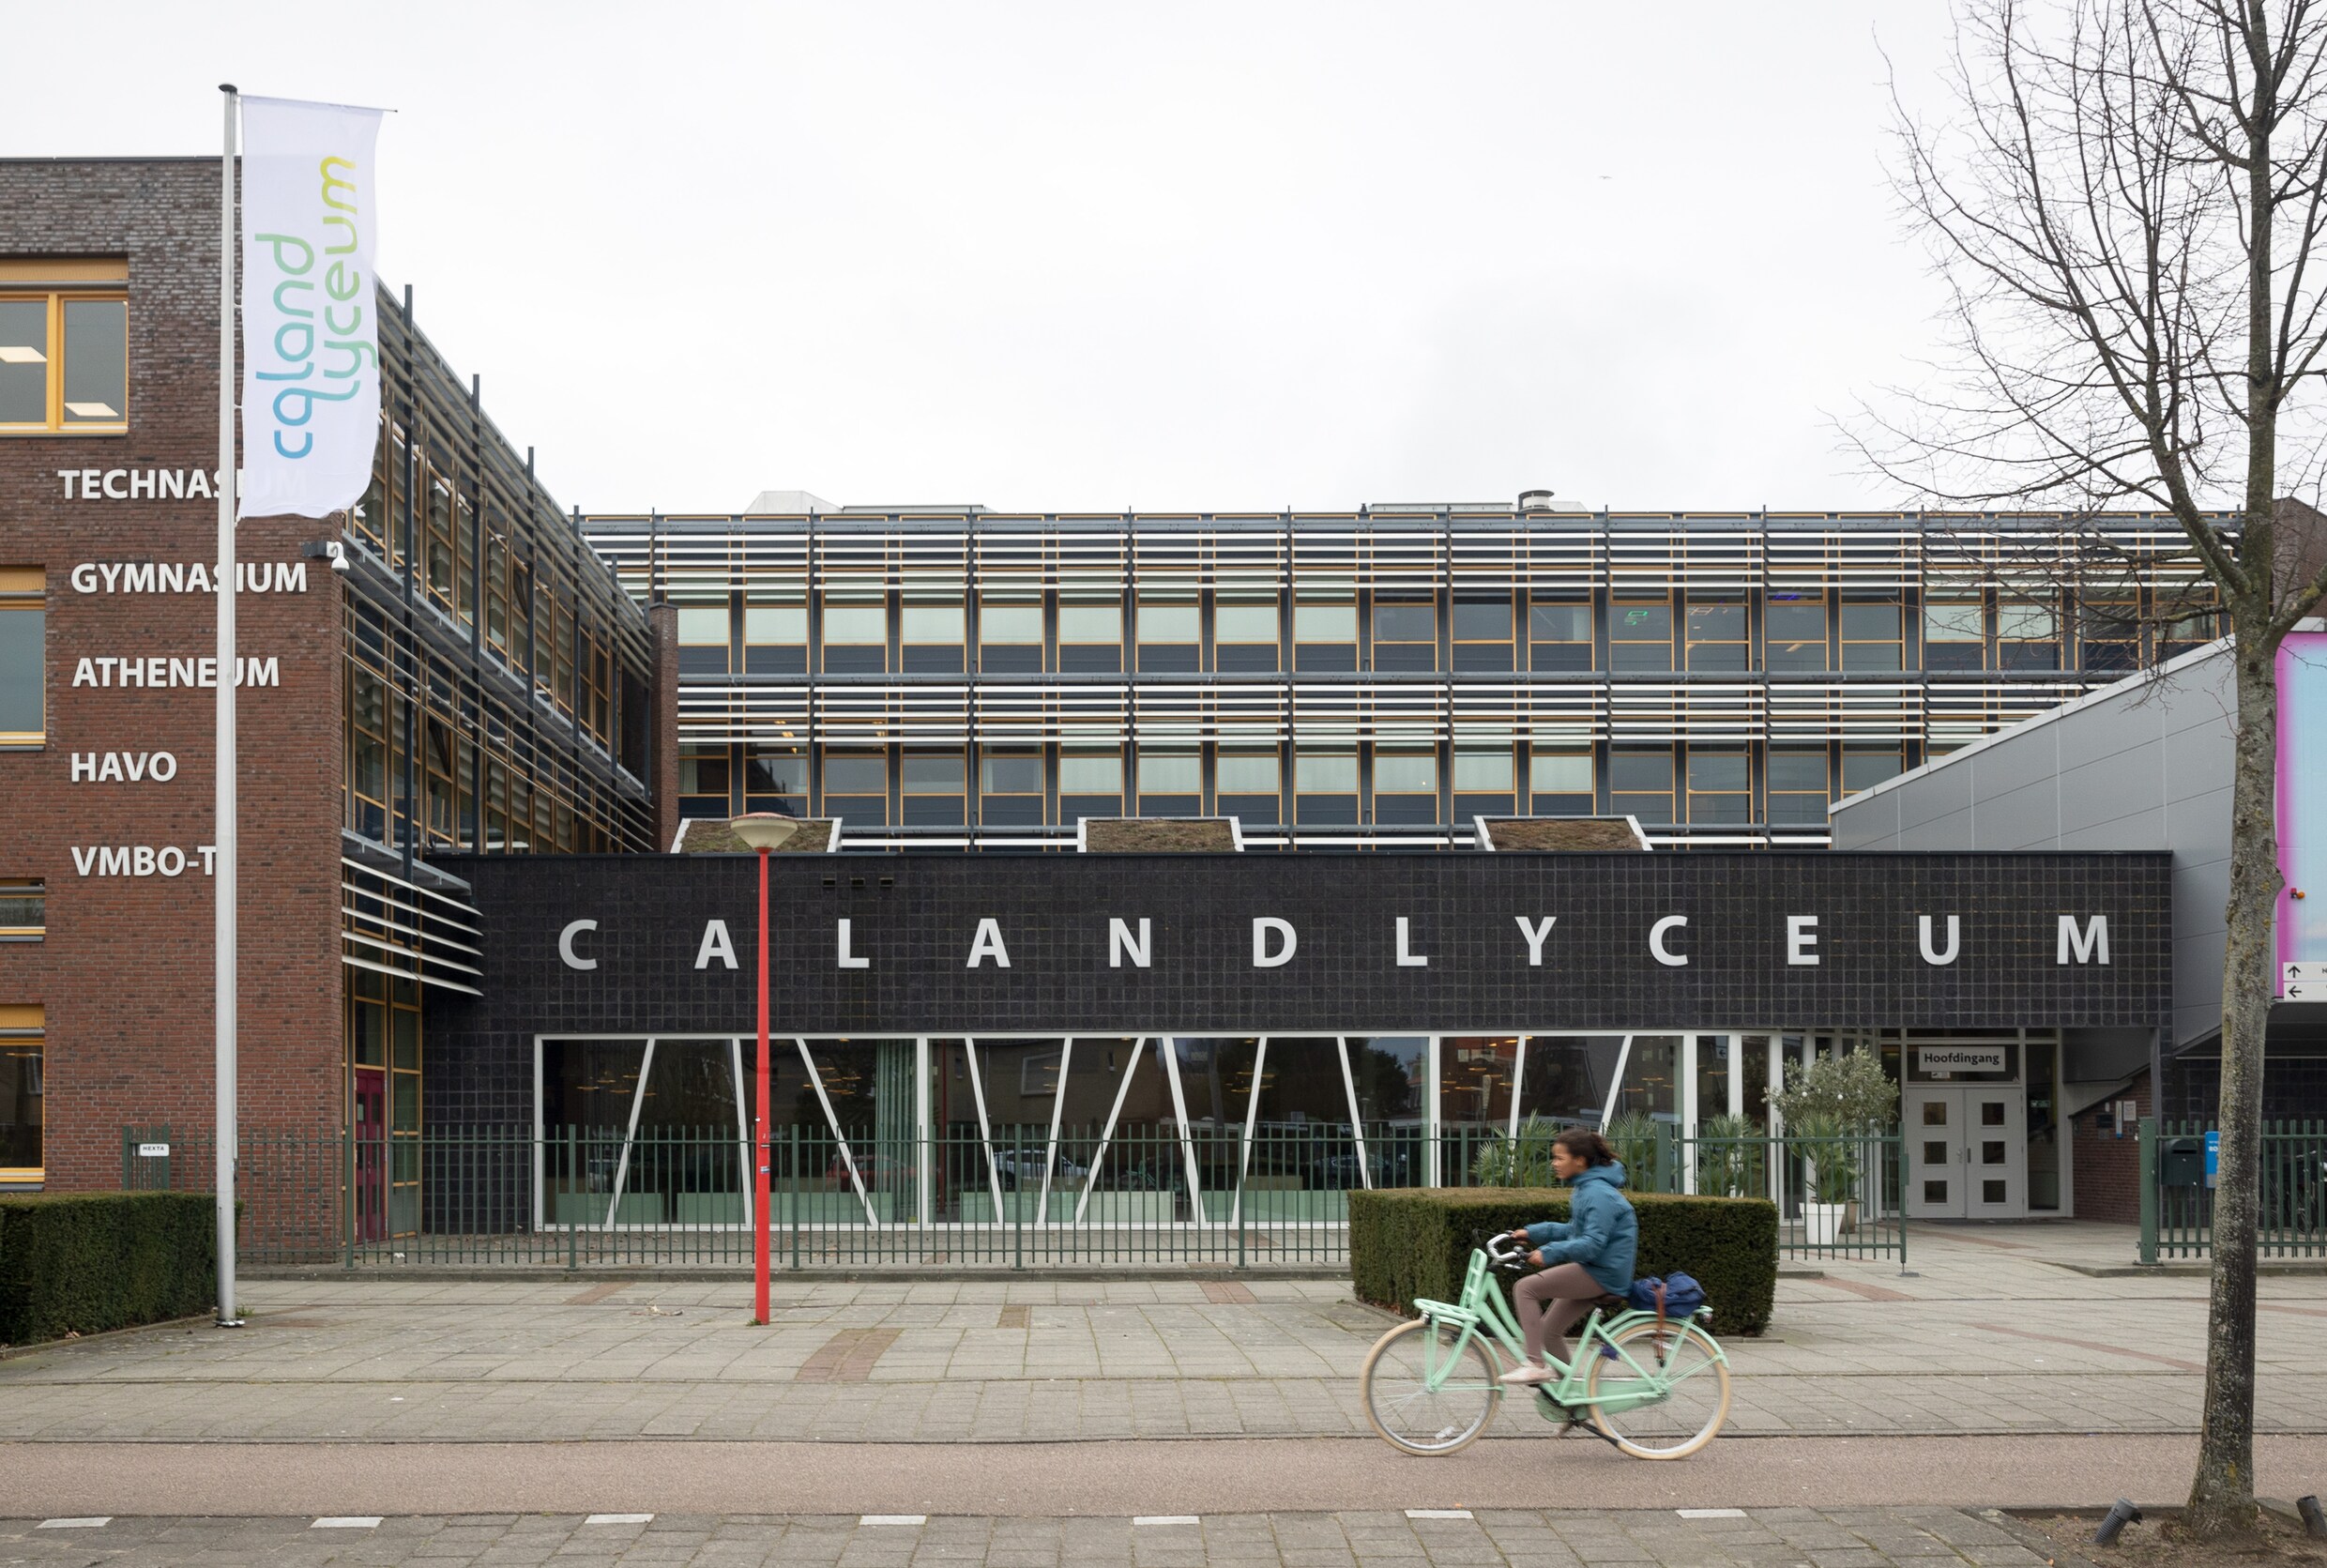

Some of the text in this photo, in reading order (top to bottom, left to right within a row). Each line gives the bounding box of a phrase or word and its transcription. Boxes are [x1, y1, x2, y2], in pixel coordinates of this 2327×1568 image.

[71, 752, 177, 783] HAVO
[70, 845, 217, 876] VMBO-T
[1924, 1052, 2000, 1066] Hoofdingang
